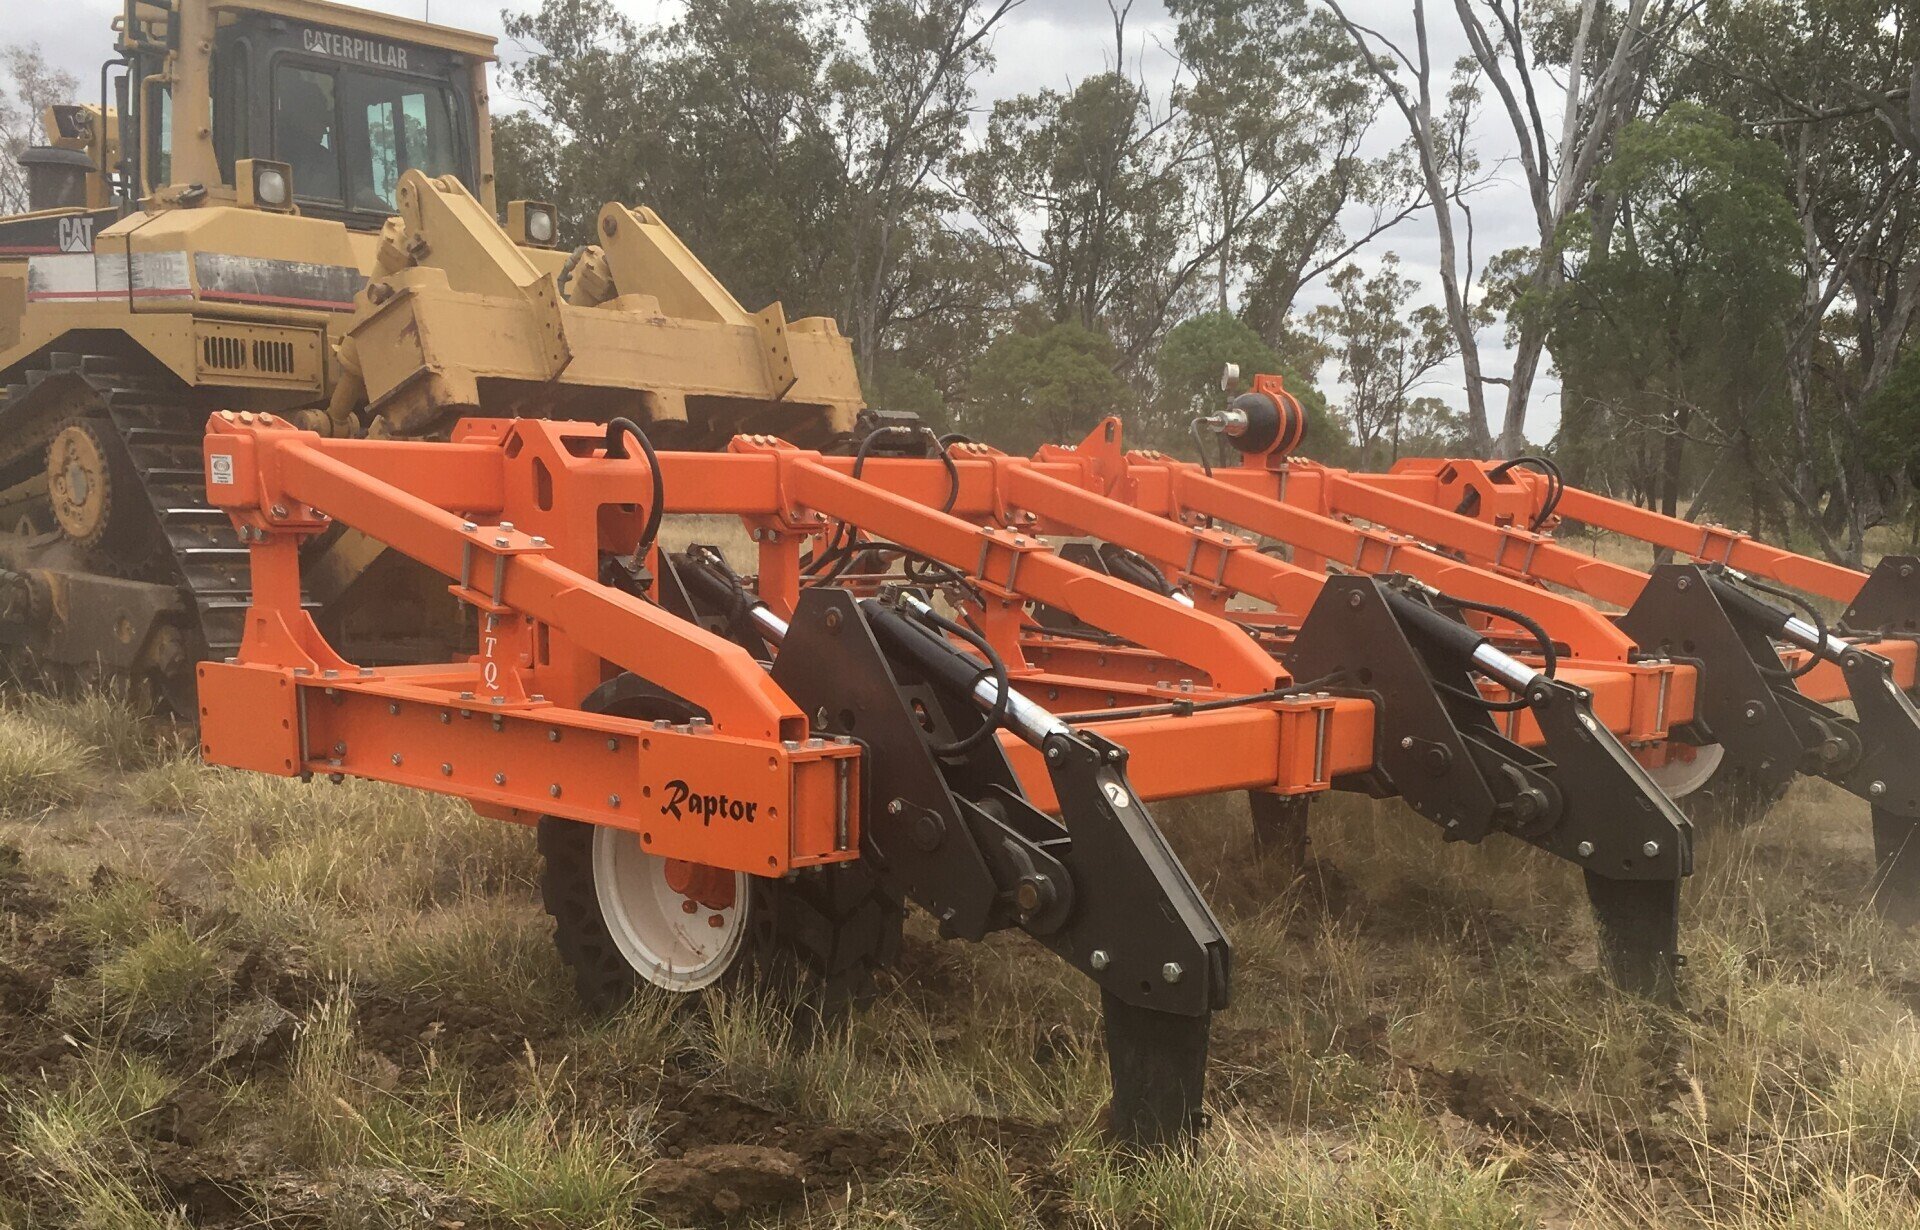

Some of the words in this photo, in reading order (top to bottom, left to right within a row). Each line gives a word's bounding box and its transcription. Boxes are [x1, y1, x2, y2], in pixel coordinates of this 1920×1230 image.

[303, 28, 408, 70] CATERPILLAR
[58, 217, 94, 253] CAT
[660, 780, 758, 827] Raptor
